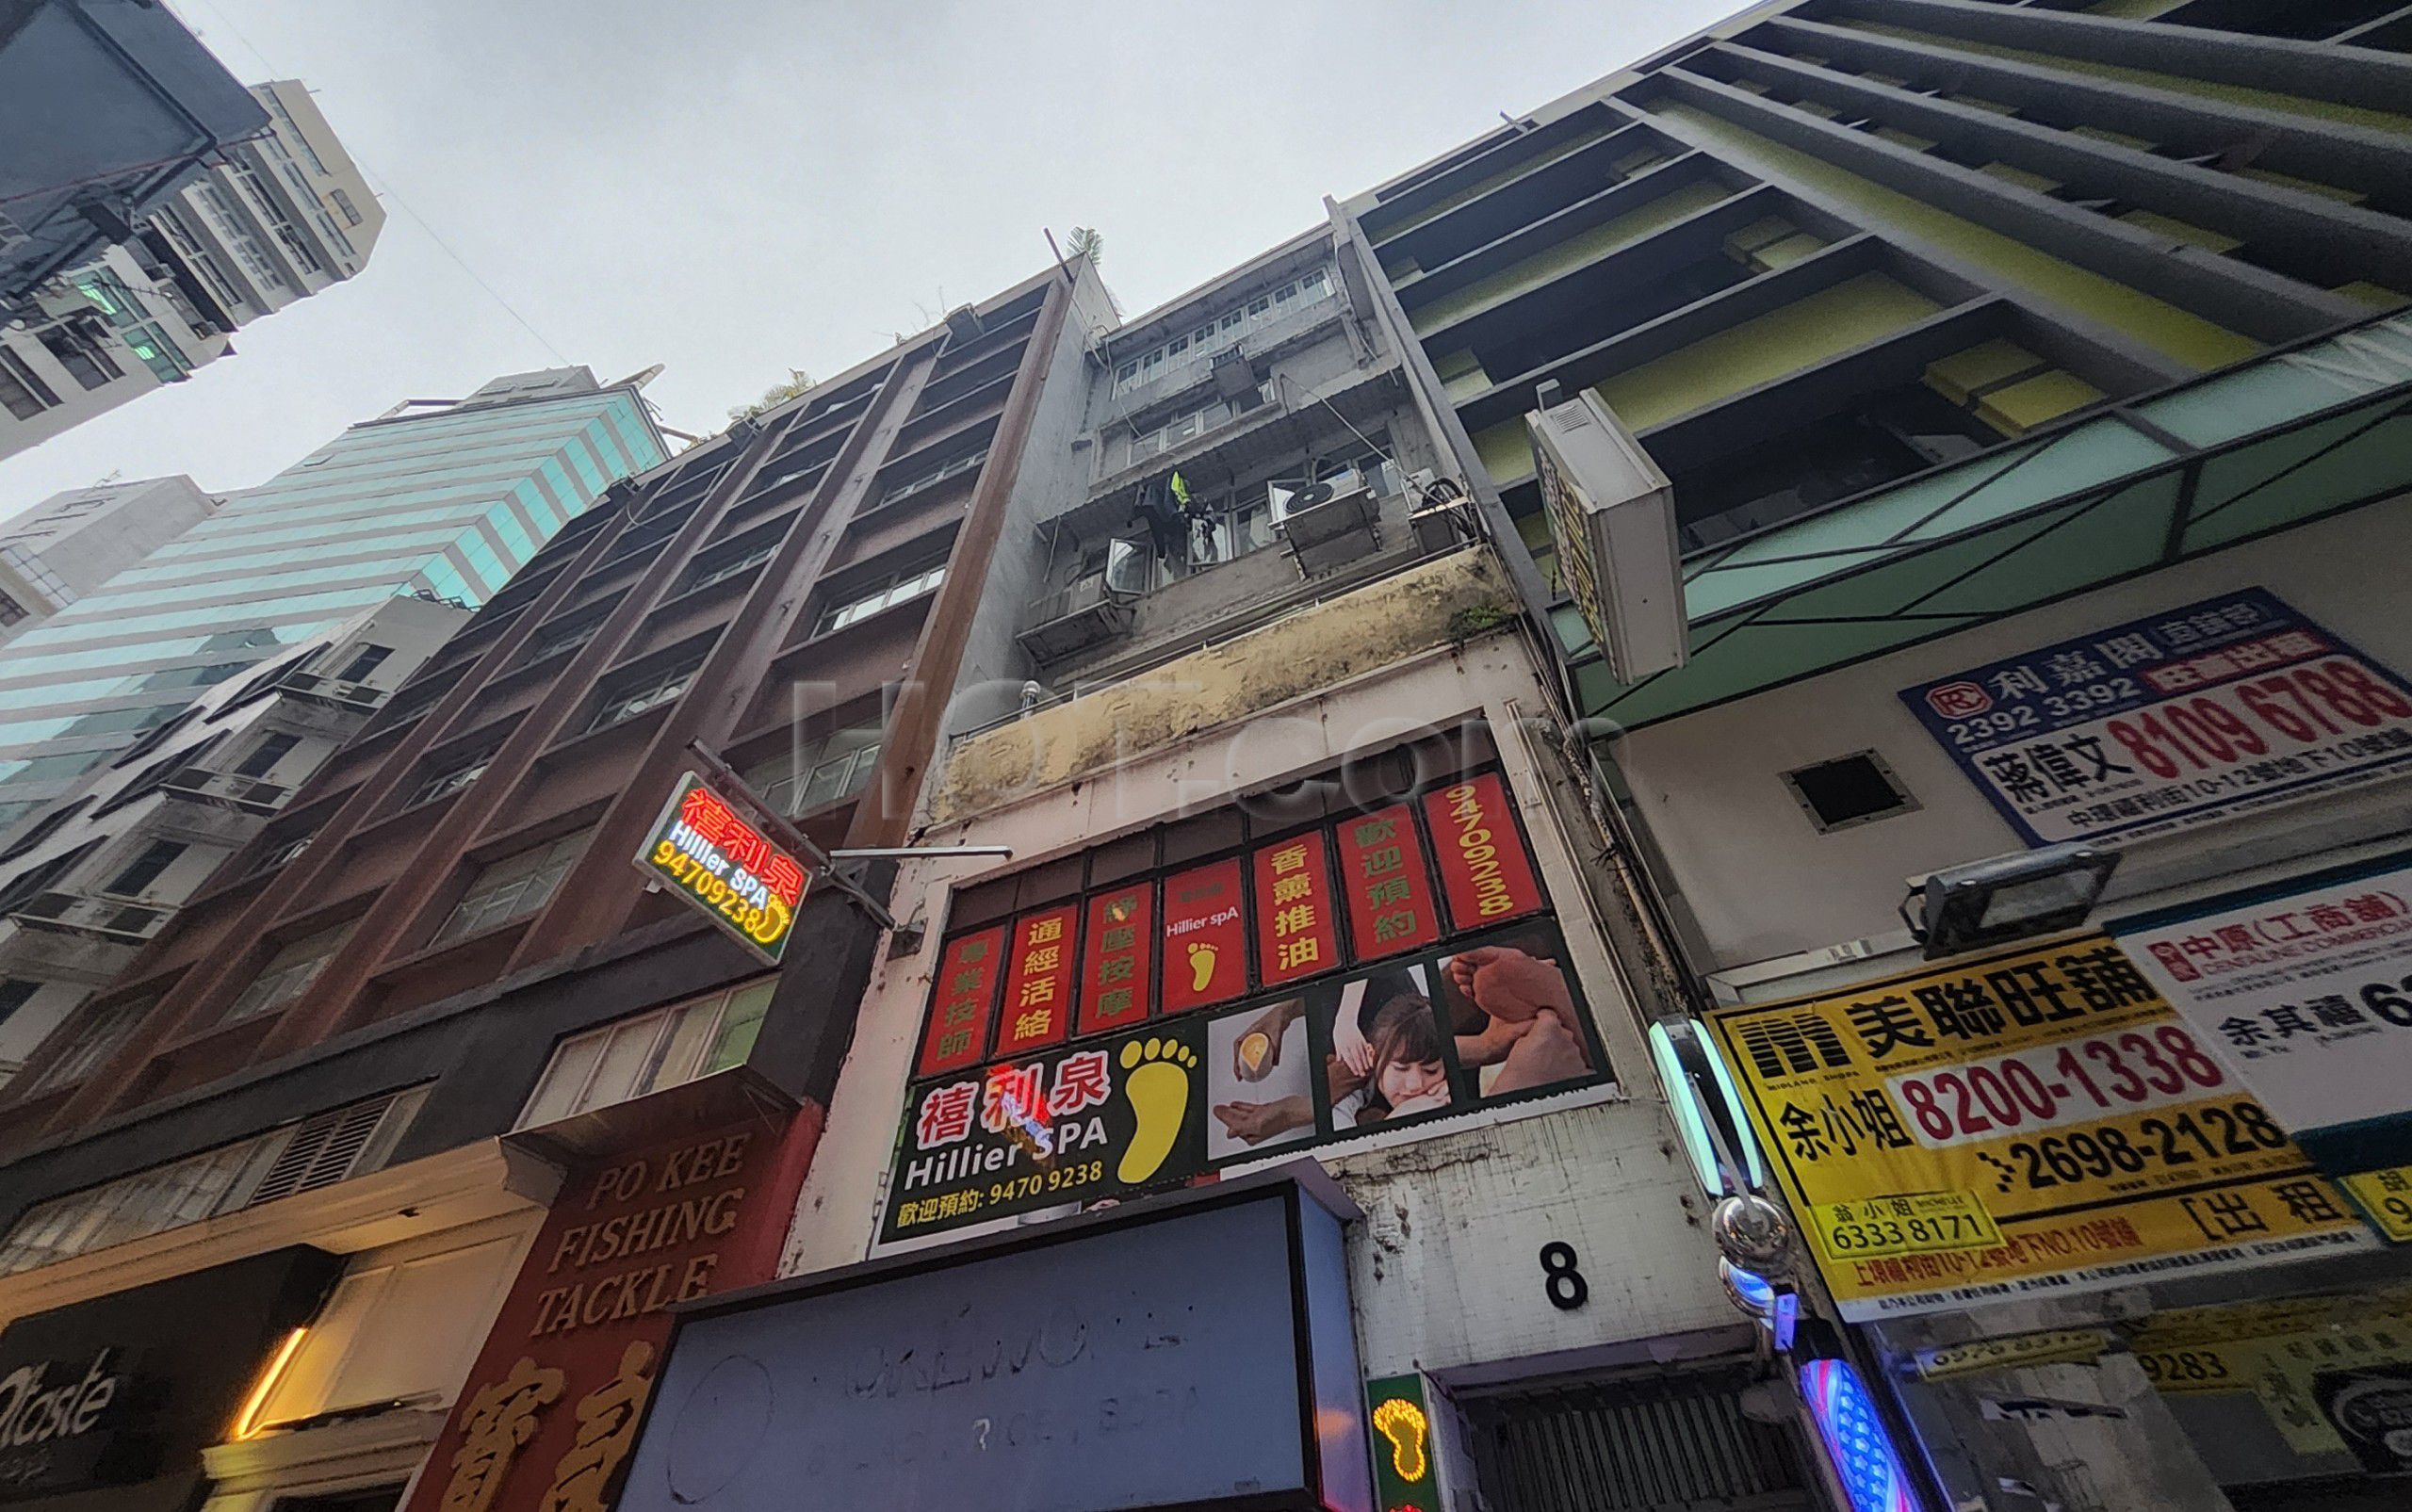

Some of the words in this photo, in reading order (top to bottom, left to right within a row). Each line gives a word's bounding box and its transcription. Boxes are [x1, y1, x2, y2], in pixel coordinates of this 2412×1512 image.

[1947, 705, 2042, 745] 2392
[2043, 676, 2142, 717] 3392
[2107, 697, 2269, 779] 8109
[2235, 661, 2412, 742] 6788
[652, 839, 759, 934] 94709238
[729, 867, 771, 911] SPA
[1354, 818, 1417, 943] 歡迎預約
[1444, 784, 1516, 918] 94709238
[1013, 916, 1063, 1042] 通經活絡
[1779, 1087, 1915, 1162] 余小姐
[1901, 1025, 2224, 1140] 8200-1338
[585, 1161, 647, 1211] PO
[656, 1132, 751, 1193] KEE
[904, 1138, 1023, 1192] Hillier
[1033, 1116, 1108, 1161] SPA
[989, 1174, 1042, 1205] 9470
[1049, 1160, 1102, 1192] 9238
[2009, 1101, 2289, 1189] 2698-2128
[546, 1187, 745, 1276] FISHING
[1832, 1220, 1905, 1250] 6333
[1906, 1212, 1982, 1243] 8171
[528, 1253, 719, 1339] TACKLE
[1540, 1241, 1589, 1311] 8
